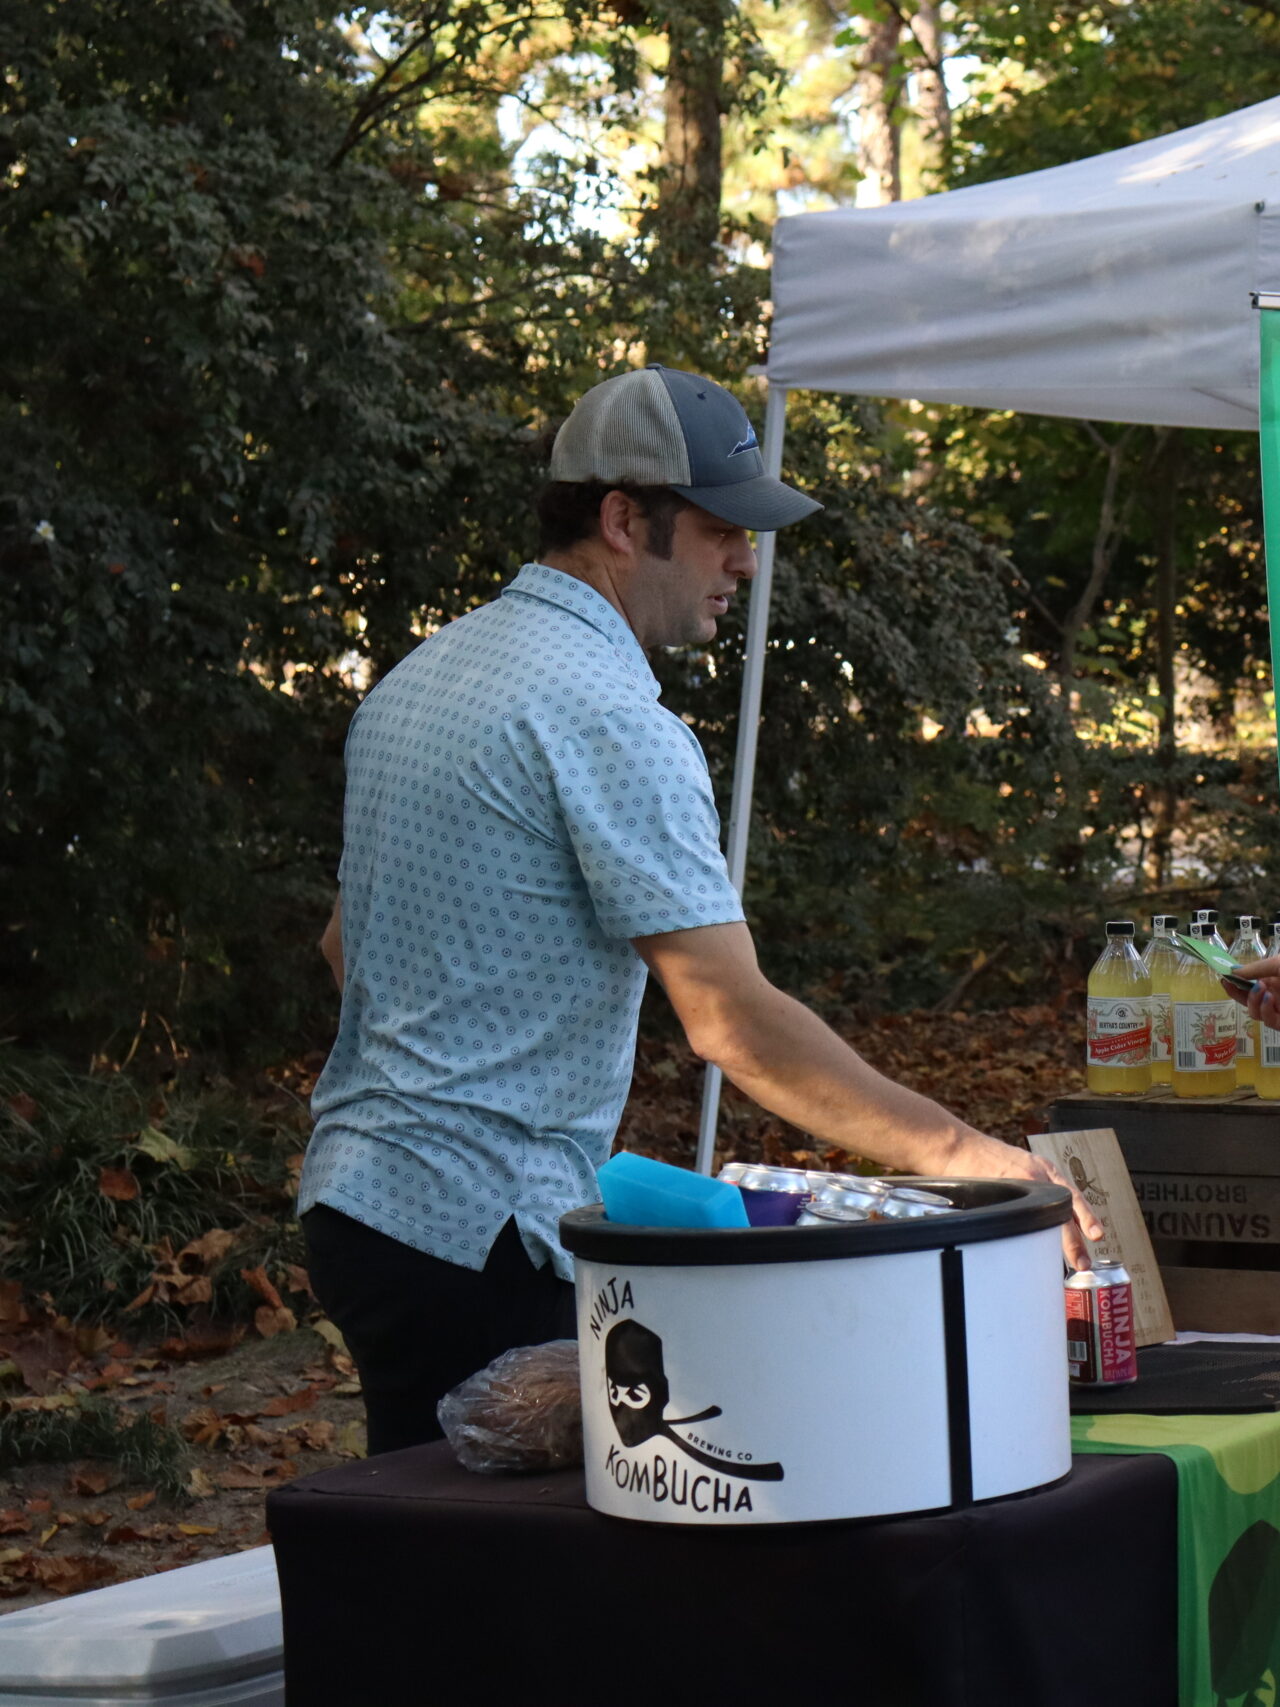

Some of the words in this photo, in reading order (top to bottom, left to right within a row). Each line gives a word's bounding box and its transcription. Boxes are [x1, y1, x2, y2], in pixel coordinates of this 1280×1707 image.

[1095, 1046, 1110, 1054] Apple
[1110, 1043, 1126, 1051] Cider
[1127, 1037, 1147, 1046] Vinegar
[590, 1276, 635, 1341] NINJA
[1099, 1289, 1114, 1367] KOMBUCHA
[1111, 1286, 1132, 1365] NINJA
[606, 1444, 754, 1514] KOMBUCHA
[687, 1432, 733, 1459] BREWING
[737, 1451, 753, 1462] CO
